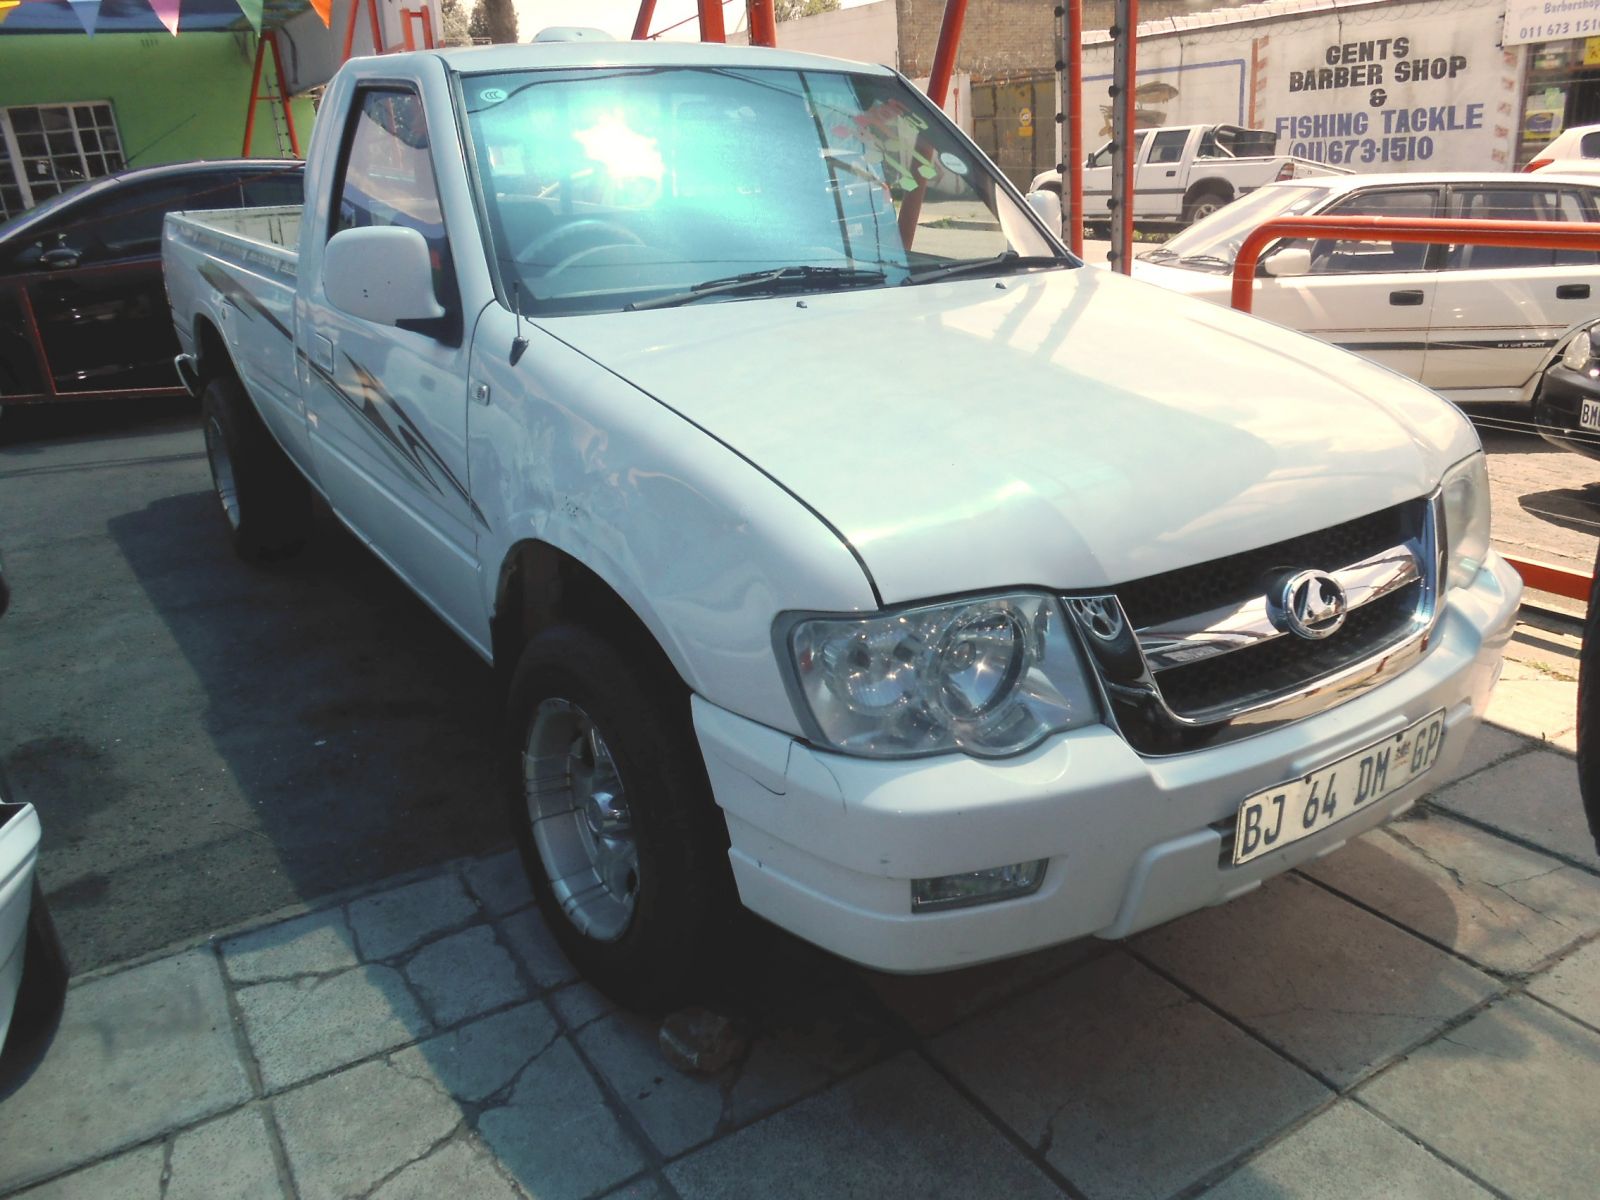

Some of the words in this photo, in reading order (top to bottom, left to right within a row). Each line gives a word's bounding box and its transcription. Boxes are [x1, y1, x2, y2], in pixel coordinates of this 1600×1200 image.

[1520, 25, 1542, 39] 011
[1547, 22, 1569, 36] 673
[1576, 19, 1600, 32] 151
[1326, 37, 1409, 65] GENTS
[1289, 64, 1383, 92] BARBER
[1394, 56, 1467, 82] SHOP
[1369, 88, 1387, 107] &
[1276, 112, 1369, 140] FISHING
[1381, 103, 1484, 134] TACKLE
[1582, 403, 1600, 428] BM
[1241, 794, 1286, 857] BJ
[1303, 772, 1337, 829] 64
[1354, 747, 1391, 805] DM
[1411, 720, 1440, 773] GP
